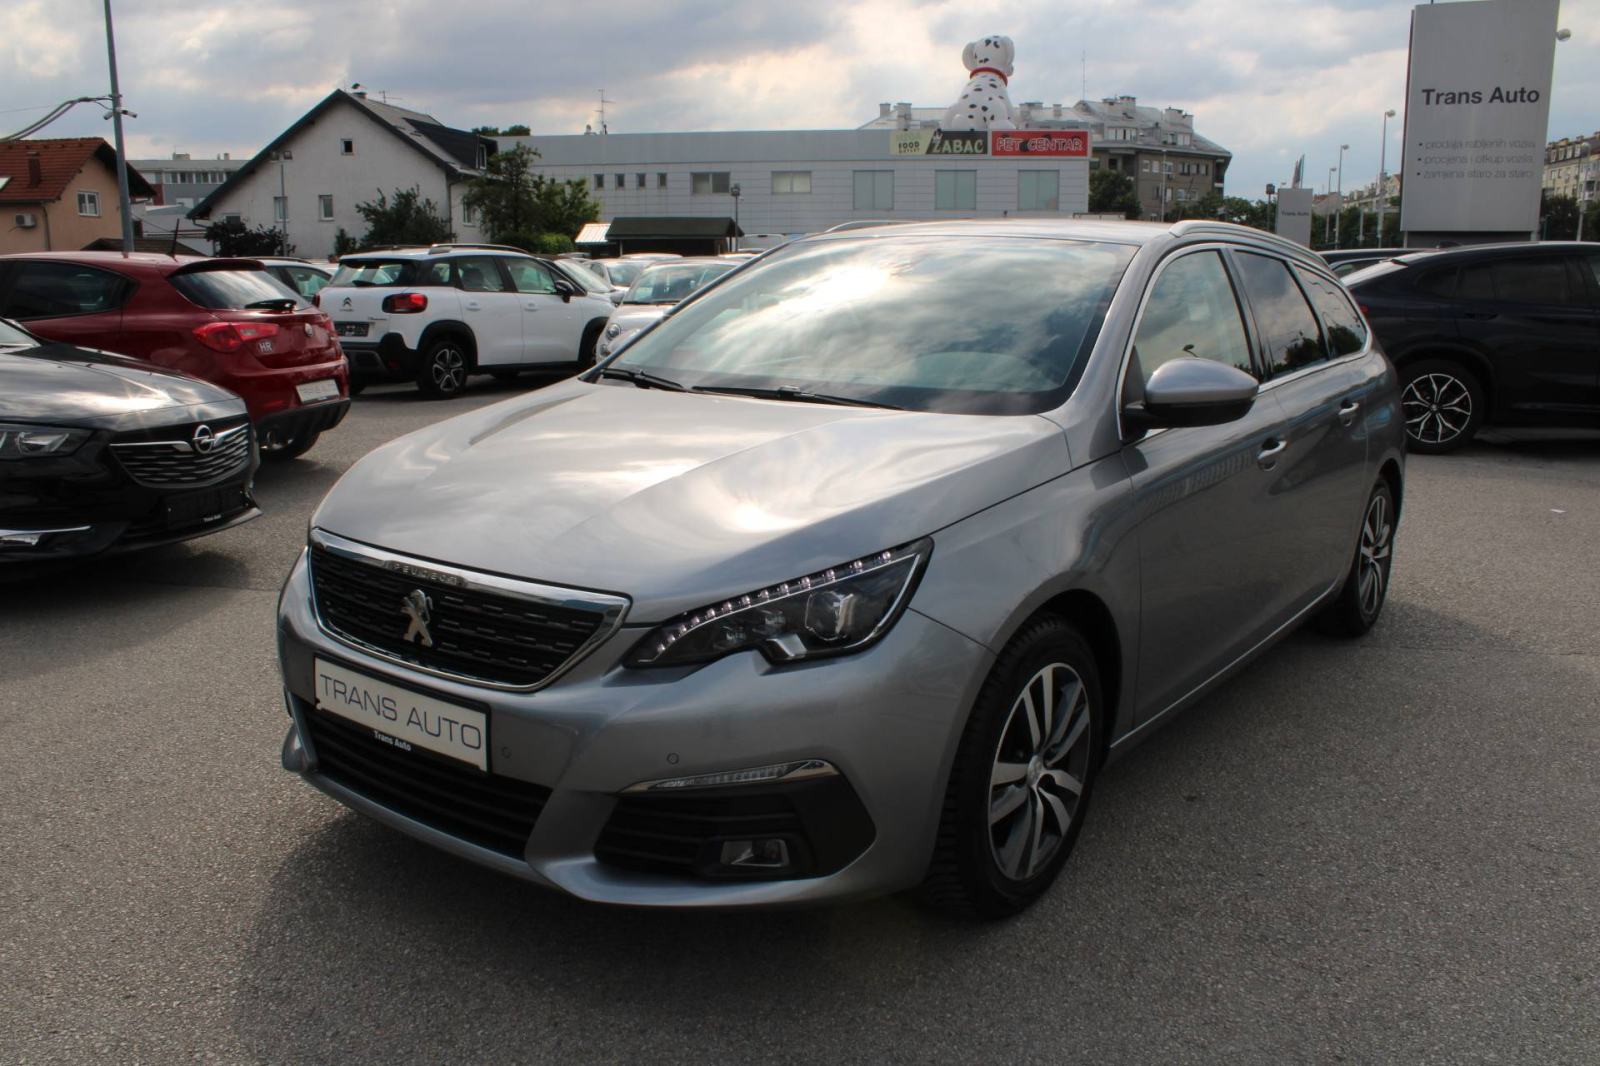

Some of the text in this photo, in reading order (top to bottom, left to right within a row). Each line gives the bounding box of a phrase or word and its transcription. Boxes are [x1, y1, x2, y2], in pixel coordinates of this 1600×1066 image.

[1422, 86, 1540, 106] Trans Auto
[997, 137, 1082, 152] PET CENTAR
[258, 341, 273, 353] HR
[320, 673, 482, 750] TRANS AUTO
[374, 730, 412, 752] Trans Auto
